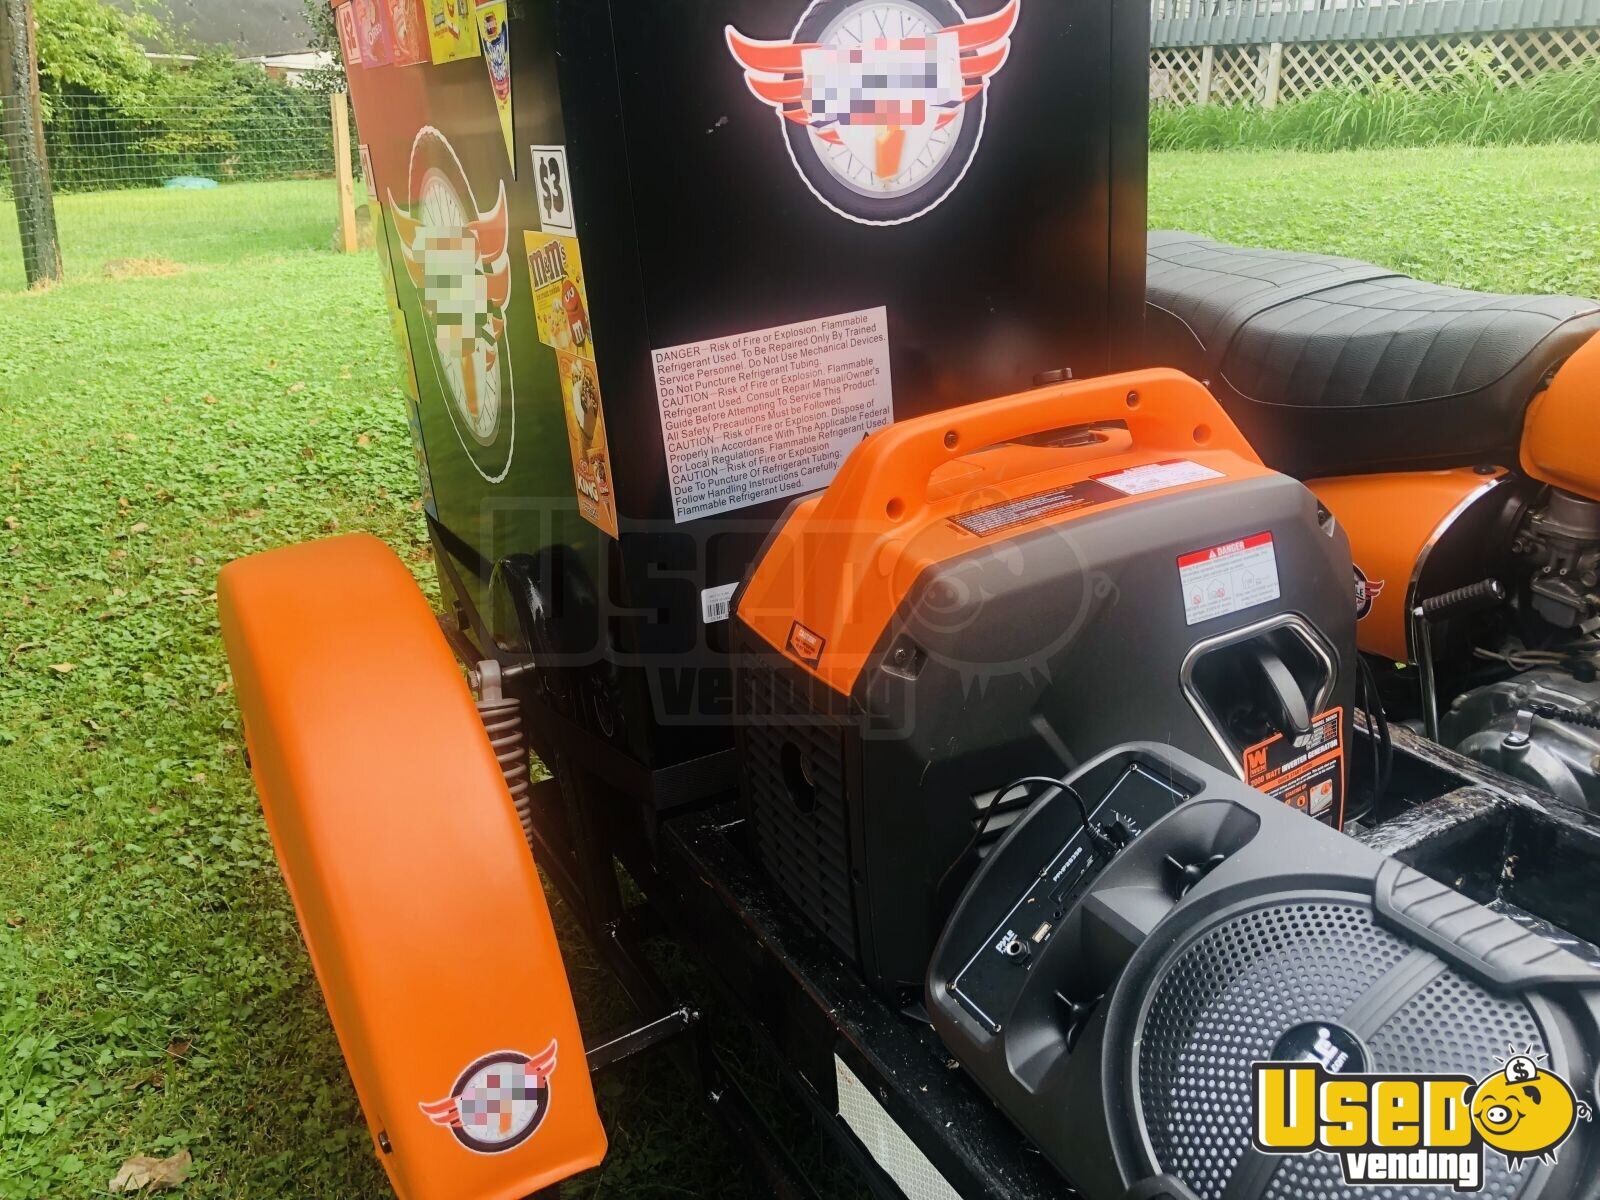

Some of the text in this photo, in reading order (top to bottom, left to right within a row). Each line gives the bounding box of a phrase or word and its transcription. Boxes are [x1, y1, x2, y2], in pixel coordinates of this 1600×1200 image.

[539, 156, 565, 219] $3
[657, 356, 711, 377] Refrigerant
[741, 348, 753, 358] To
[753, 346, 767, 356] Be
[768, 336, 809, 355] Repaired
[810, 333, 830, 345] Only
[831, 330, 843, 341] By
[844, 322, 877, 337] Trained
[732, 338, 741, 349] of
[742, 336, 761, 347] Fire
[762, 334, 772, 343] or
[821, 313, 868, 331] Flammable
[658, 372, 695, 386] Service
[748, 358, 762, 369] Do
[762, 354, 779, 366] Not
[780, 351, 798, 362] Use
[799, 339, 849, 358] Mechanical
[660, 387, 675, 398] Do
[676, 383, 694, 395] Not
[694, 374, 737, 391] Puncture
[738, 363, 789, 382] Refrigerant
[739, 382, 749, 393] of
[750, 380, 768, 391] Fire
[769, 377, 779, 387] or
[827, 357, 874, 374] Flammable
[663, 401, 717, 422] Refrigerant
[746, 387, 781, 403] Consult
[782, 381, 811, 396] Repair
[812, 366, 880, 388] Manual/Owner's
[665, 417, 694, 431] Guide
[695, 411, 726, 425] Before
[727, 401, 775, 419] Attempting
[776, 397, 788, 407] To
[789, 389, 822, 404] Service
[823, 386, 841, 396] This
[666, 430, 679, 443] All
[680, 425, 711, 439] Safety
[712, 414, 766, 433] Precautions
[767, 407, 790, 420] Must
[790, 405, 802, 415] be
[669, 405, 890, 465] Properly In Accordance With The Applicable Federal
[744, 425, 754, 436] of
[755, 423, 773, 434] Fire
[774, 421, 784, 430] or
[831, 402, 865, 417] Dispose
[866, 398, 874, 408] of
[671, 464, 683, 474] Or
[684, 456, 710, 472] Local
[769, 433, 817, 452] Flammable
[818, 421, 864, 441] Refrigerant
[748, 457, 757, 468] of
[758, 455, 776, 466] Fire
[777, 452, 787, 461] or
[673, 484, 693, 496] Due
[694, 481, 706, 491] To
[707, 472, 748, 488] Puncture
[749, 467, 760, 478] Of
[761, 456, 811, 476] Refrigerant
[675, 492, 706, 507] Follow
[707, 483, 748, 500] Handling
[748, 470, 799, 489] Instructions
[676, 497, 727, 517] Flammable
[728, 484, 778, 505] Refrigerant
[1216, 540, 1246, 557] DANGER
